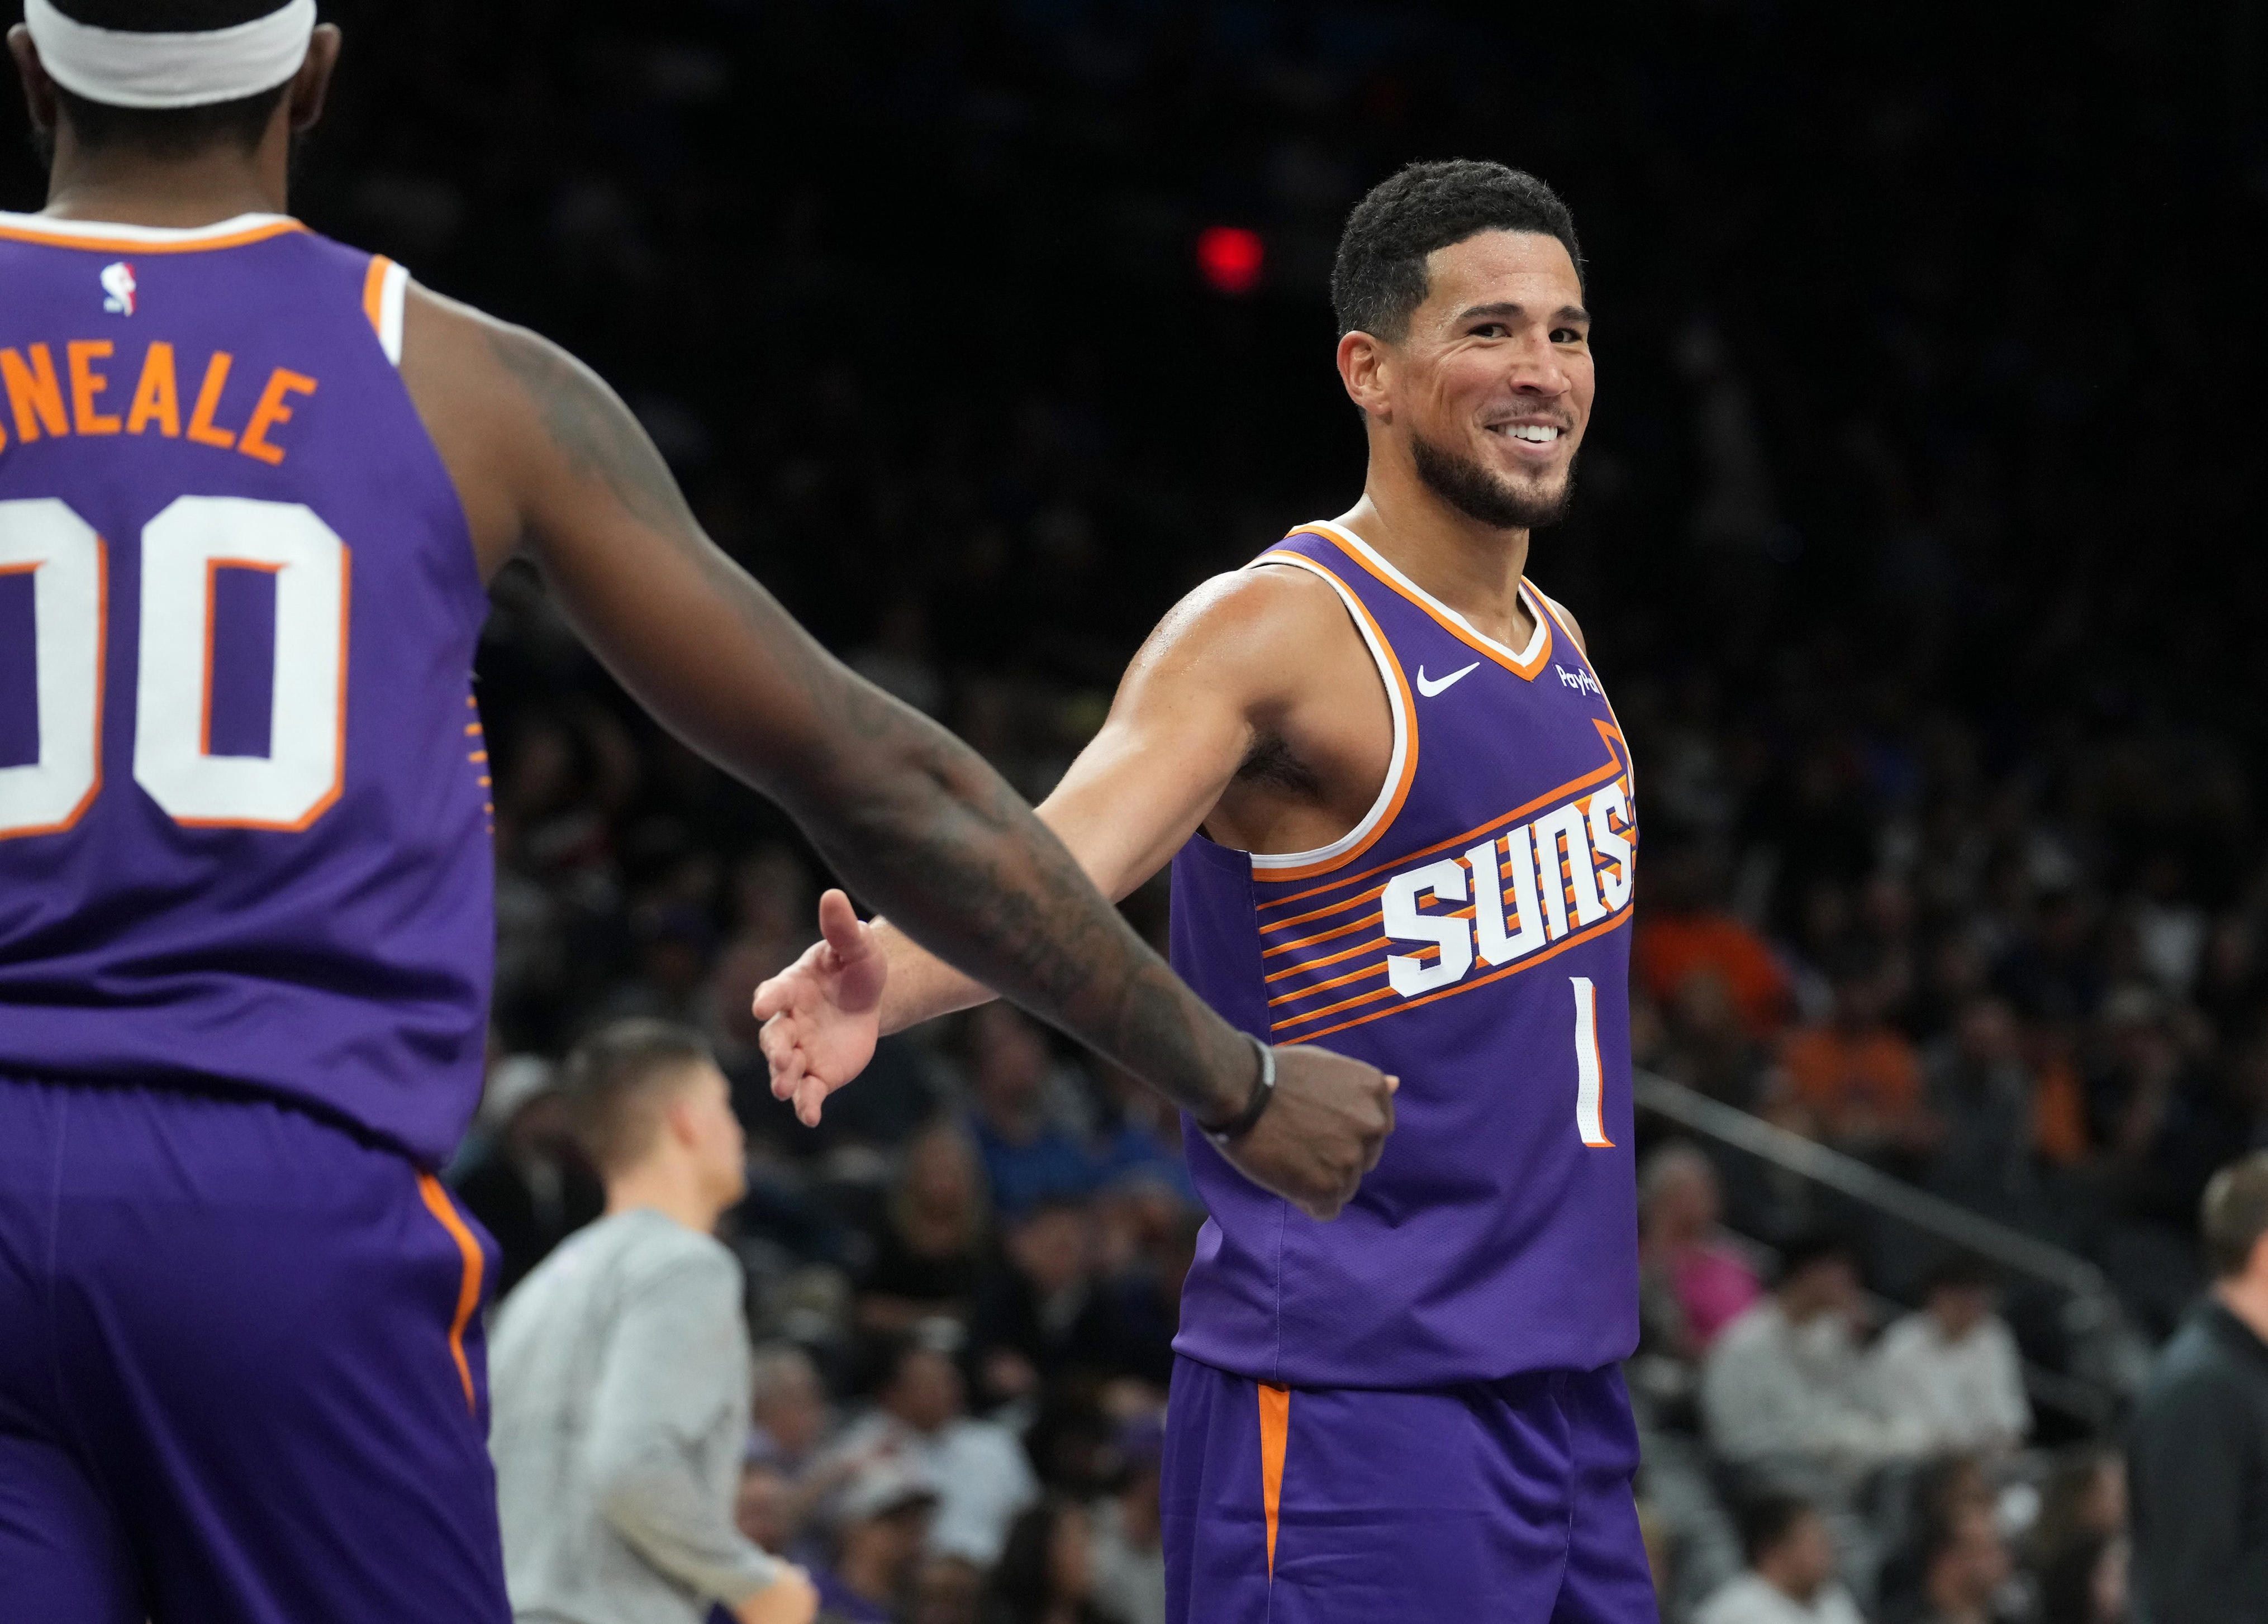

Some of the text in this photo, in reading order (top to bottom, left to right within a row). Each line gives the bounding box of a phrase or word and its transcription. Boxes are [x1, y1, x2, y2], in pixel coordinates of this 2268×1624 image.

[0, 341, 317, 464] NEALE
[1381, 782, 1633, 998] SUNS
[1569, 977, 1615, 1147] 1
